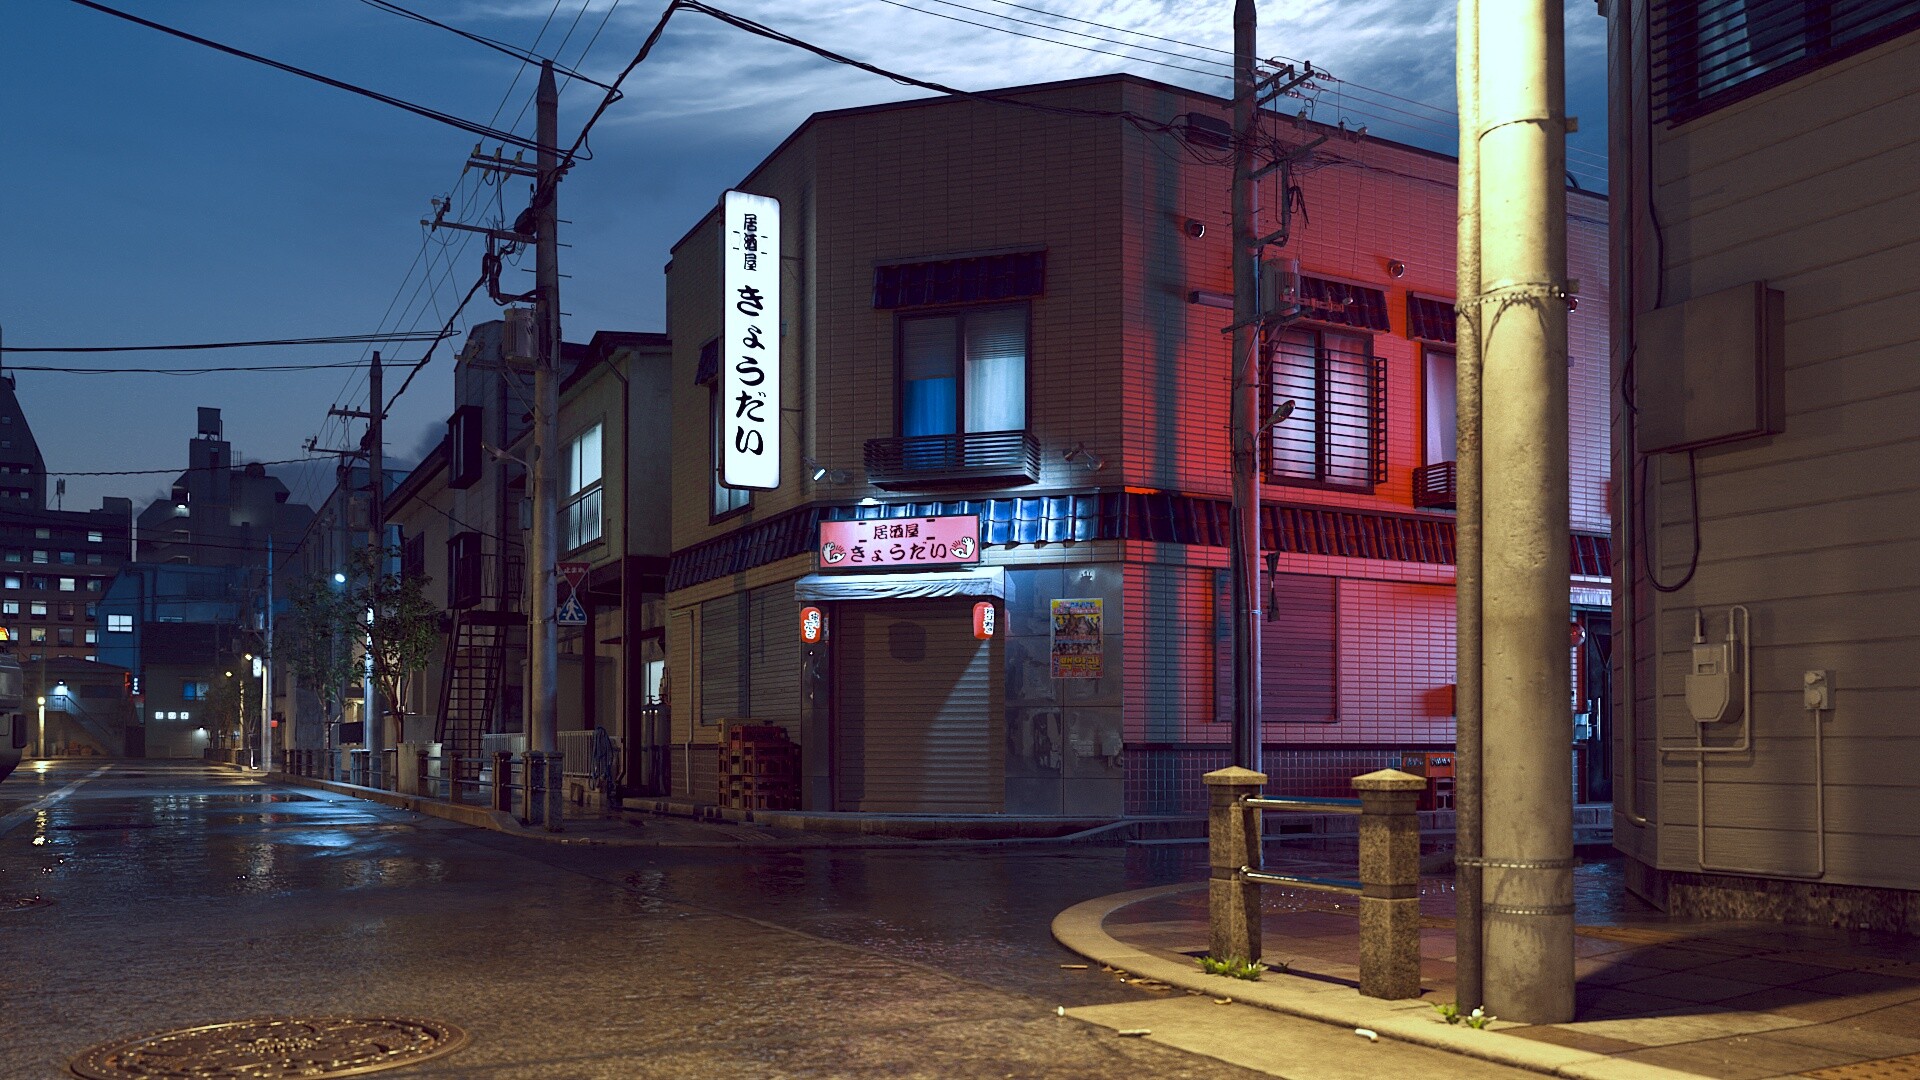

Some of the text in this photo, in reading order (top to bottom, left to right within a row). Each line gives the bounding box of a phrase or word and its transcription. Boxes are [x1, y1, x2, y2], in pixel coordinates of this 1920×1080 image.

[743, 213, 758, 271] 居酒屋
[735, 285, 767, 456] きょうだい
[873, 523, 919, 540] 居酒屋
[850, 541, 947, 563] きょうだい
